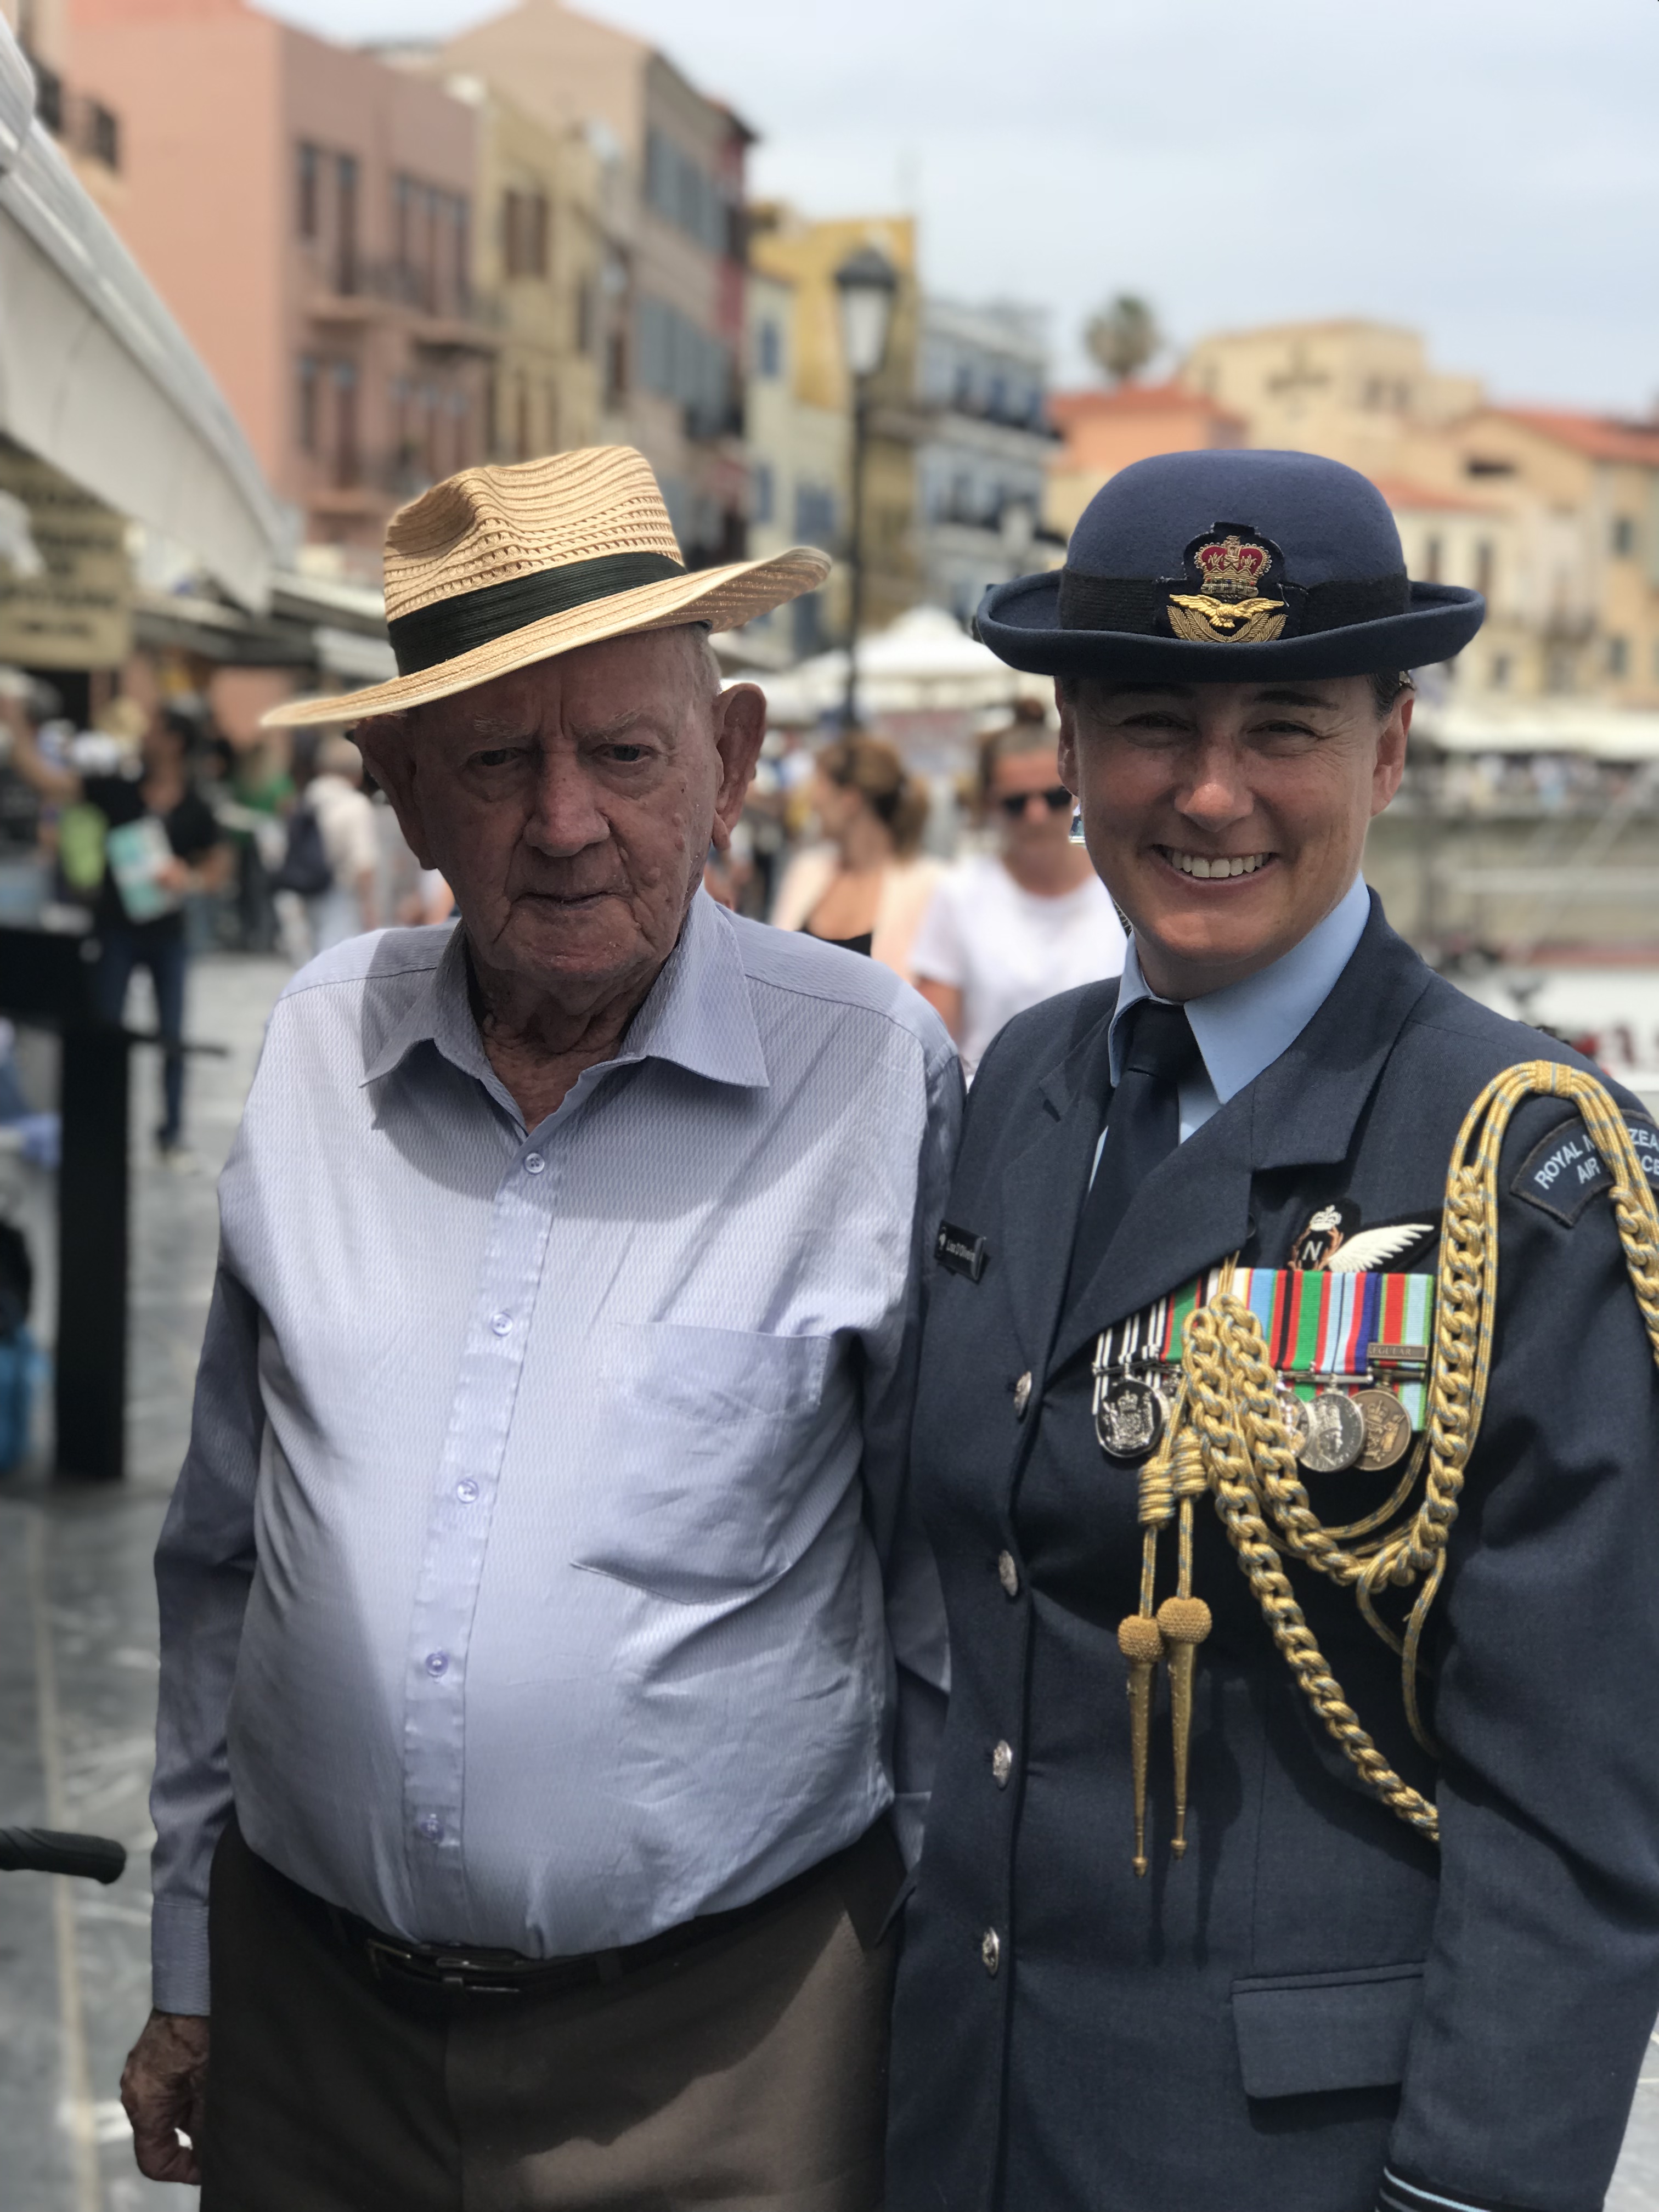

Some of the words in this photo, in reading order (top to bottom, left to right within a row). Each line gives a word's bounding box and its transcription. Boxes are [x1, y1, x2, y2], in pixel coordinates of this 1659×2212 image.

[1534, 1141, 1583, 1190] ROYAL
[1577, 1156, 1601, 1184] AIR
[1302, 1240, 1323, 1261] N
